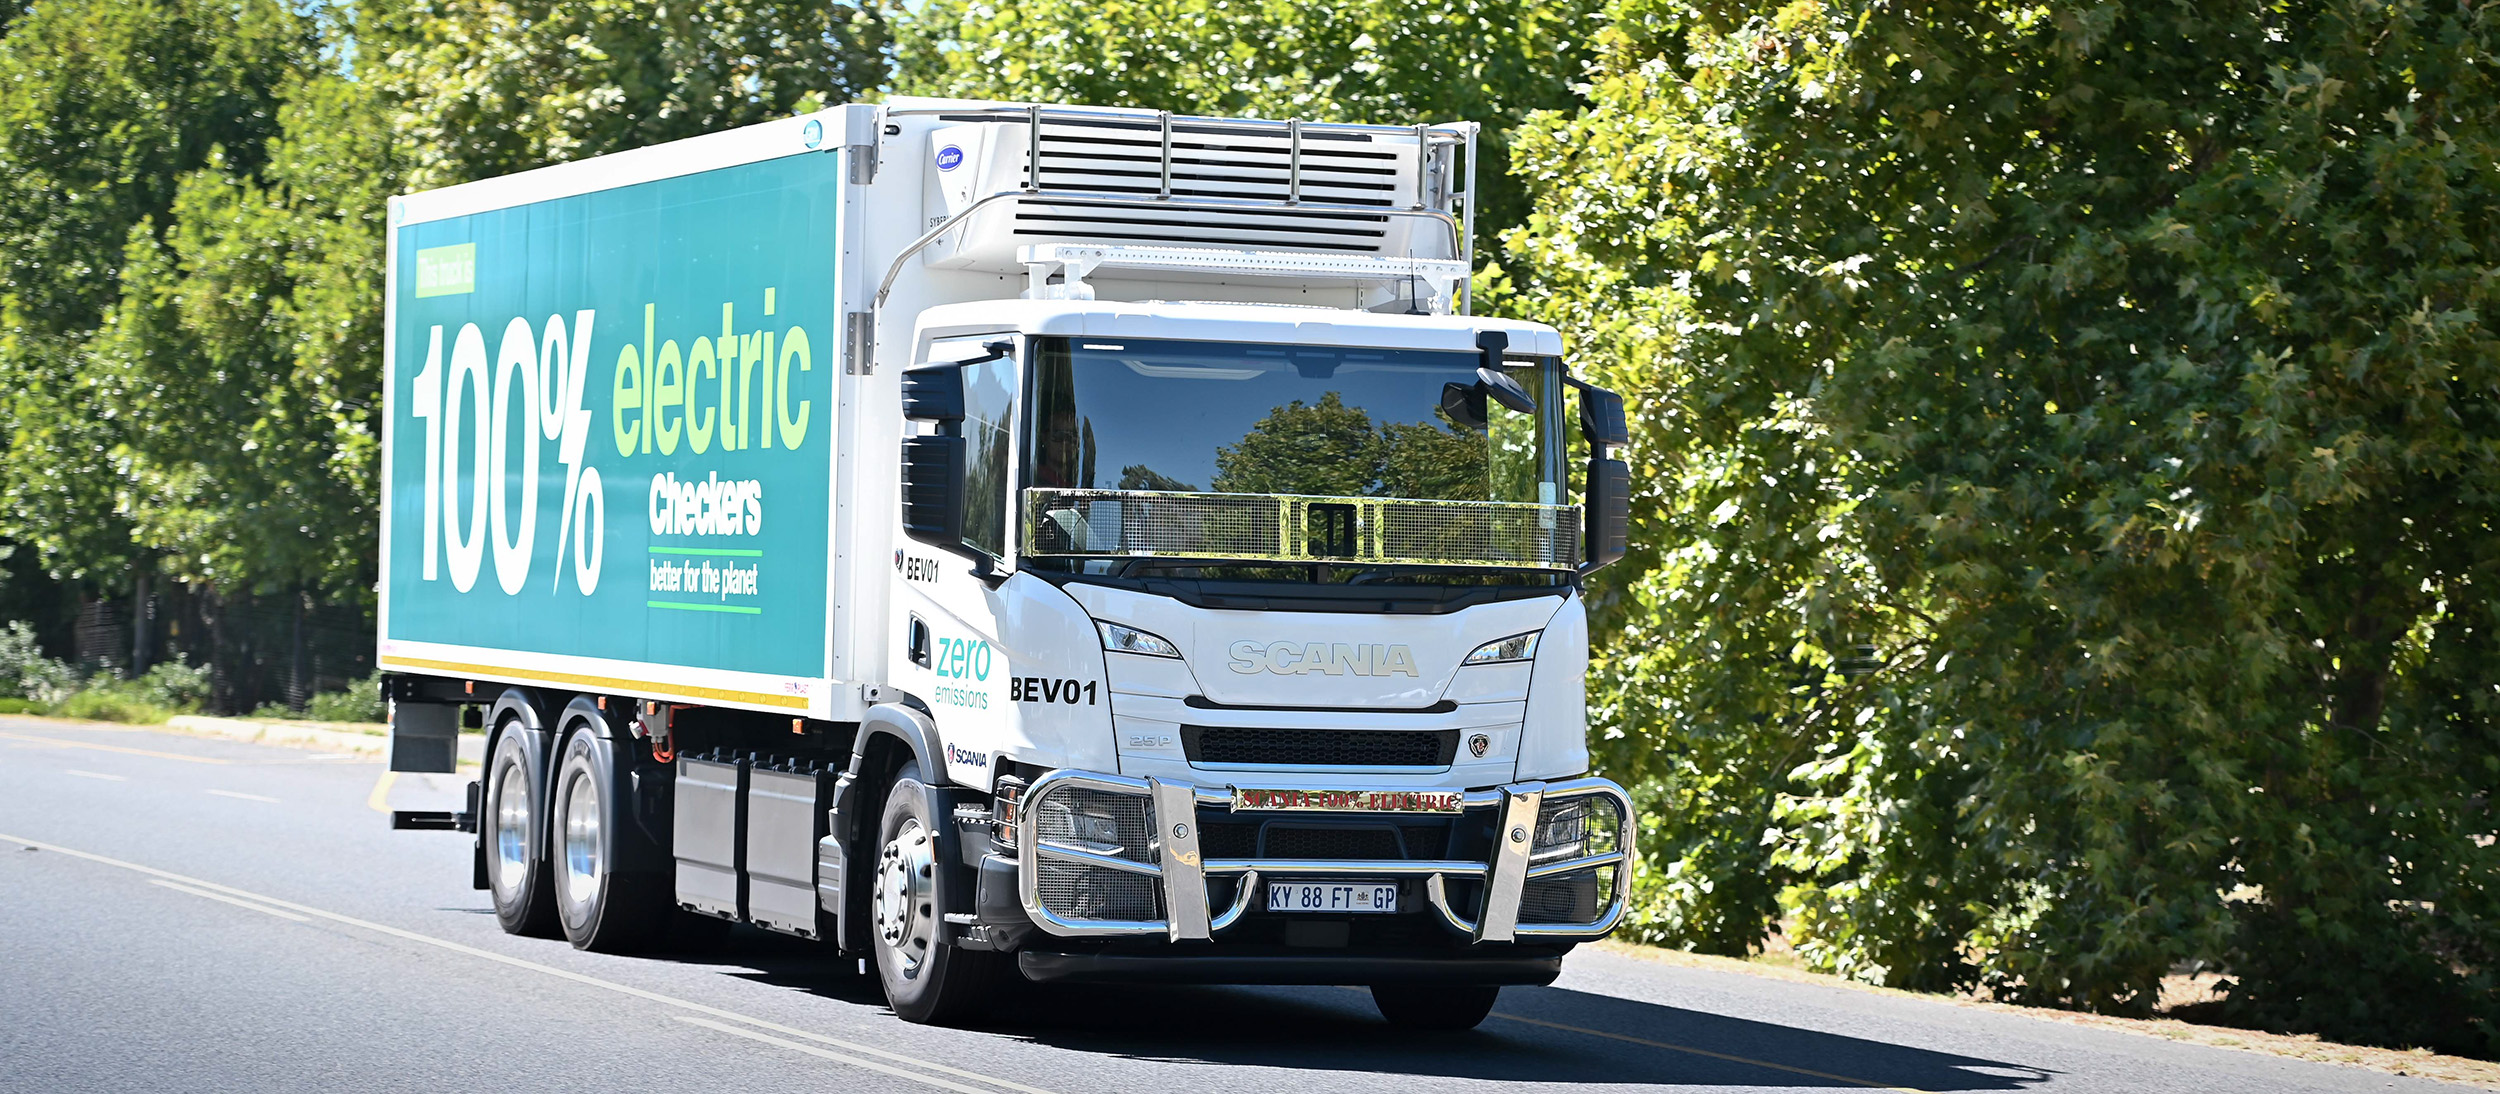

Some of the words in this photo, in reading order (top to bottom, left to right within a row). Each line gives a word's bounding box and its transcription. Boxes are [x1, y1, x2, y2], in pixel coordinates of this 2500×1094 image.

[938, 152, 960, 165] Carrier
[612, 287, 812, 457] electric
[412, 309, 604, 596] 100%
[649, 470, 762, 536] Checkers
[650, 558, 682, 592] better
[683, 559, 700, 593] for
[701, 560, 720, 593] the
[721, 560, 758, 601] planet
[906, 556, 940, 584] BEV01
[936, 637, 992, 682] zero
[1227, 639, 1420, 678] SCANIA
[935, 682, 988, 710] emissions
[1010, 676, 1098, 706] BEV01
[956, 748, 987, 768] SCANIA
[1243, 790, 1311, 808] SCANIA
[1317, 791, 1364, 809] 100%
[1369, 792, 1460, 811] ELECTRIC
[1270, 886, 1292, 908] KY
[1301, 886, 1322, 908] 88
[1331, 887, 1353, 909] FT
[1373, 887, 1395, 909] GP
